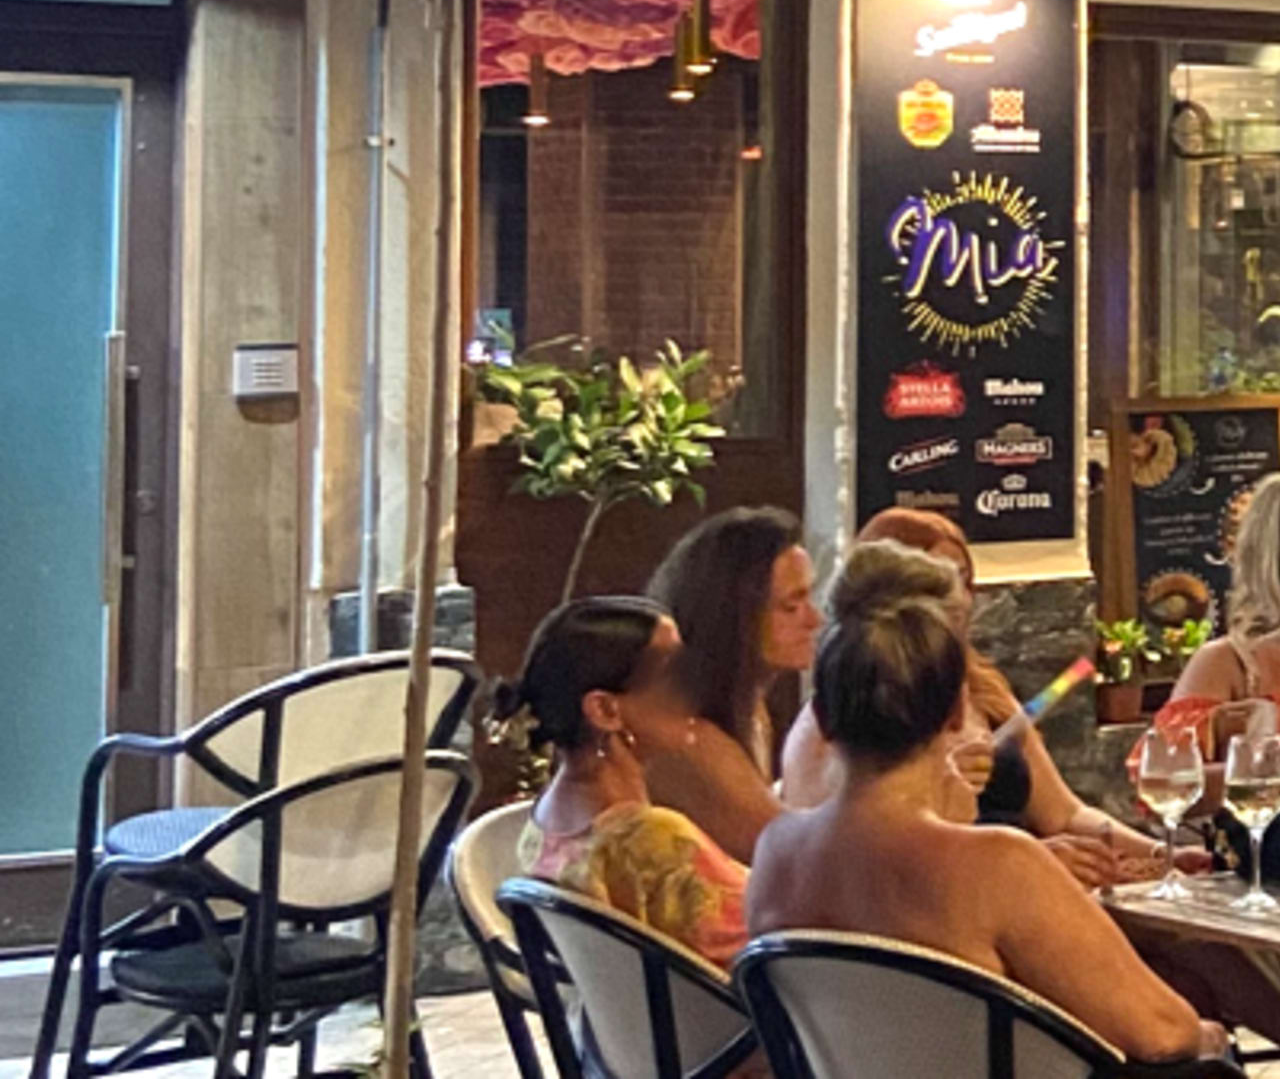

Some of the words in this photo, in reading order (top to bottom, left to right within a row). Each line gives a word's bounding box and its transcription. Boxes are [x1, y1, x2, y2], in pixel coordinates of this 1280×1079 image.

[889, 195, 1059, 306] Mia
[900, 382, 951, 395] STELLA
[888, 439, 961, 472] CARLING
[975, 489, 1053, 517] Corona
